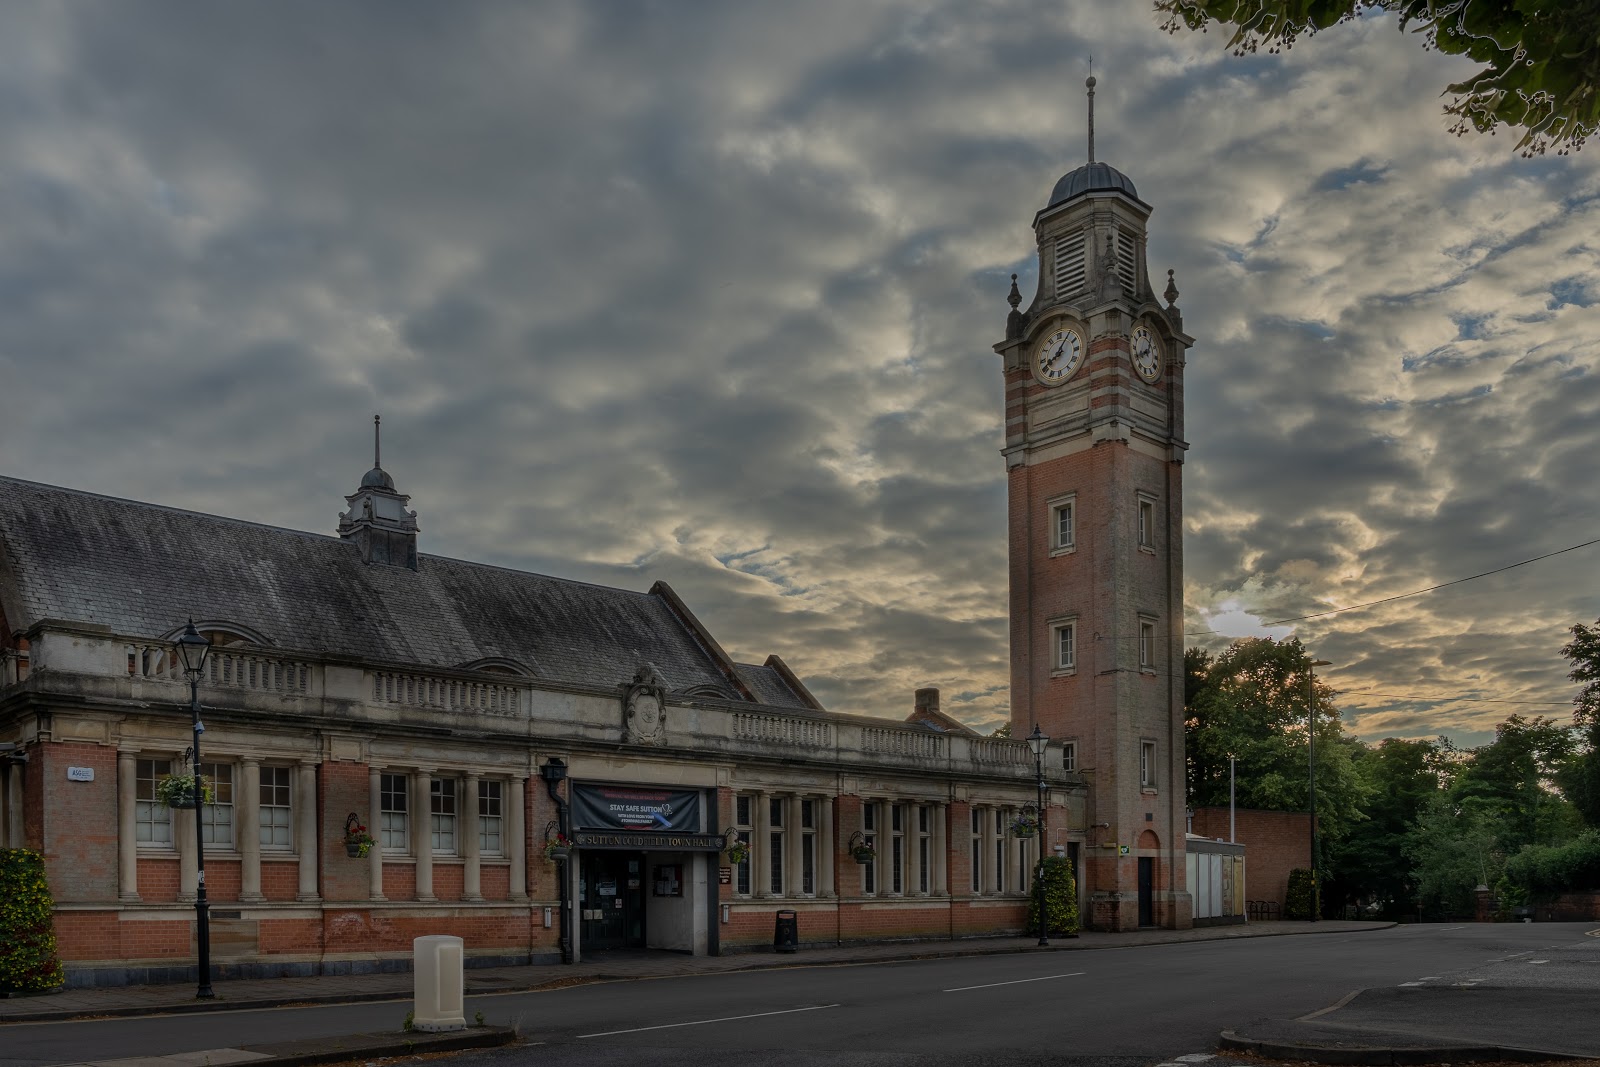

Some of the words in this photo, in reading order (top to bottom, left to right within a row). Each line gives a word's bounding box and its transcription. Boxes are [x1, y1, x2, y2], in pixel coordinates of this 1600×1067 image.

[587, 836, 620, 844] SUTTON
[622, 837, 665, 846] COLDFIELD
[668, 838, 690, 846] TOWN
[693, 839, 711, 847] HALL
